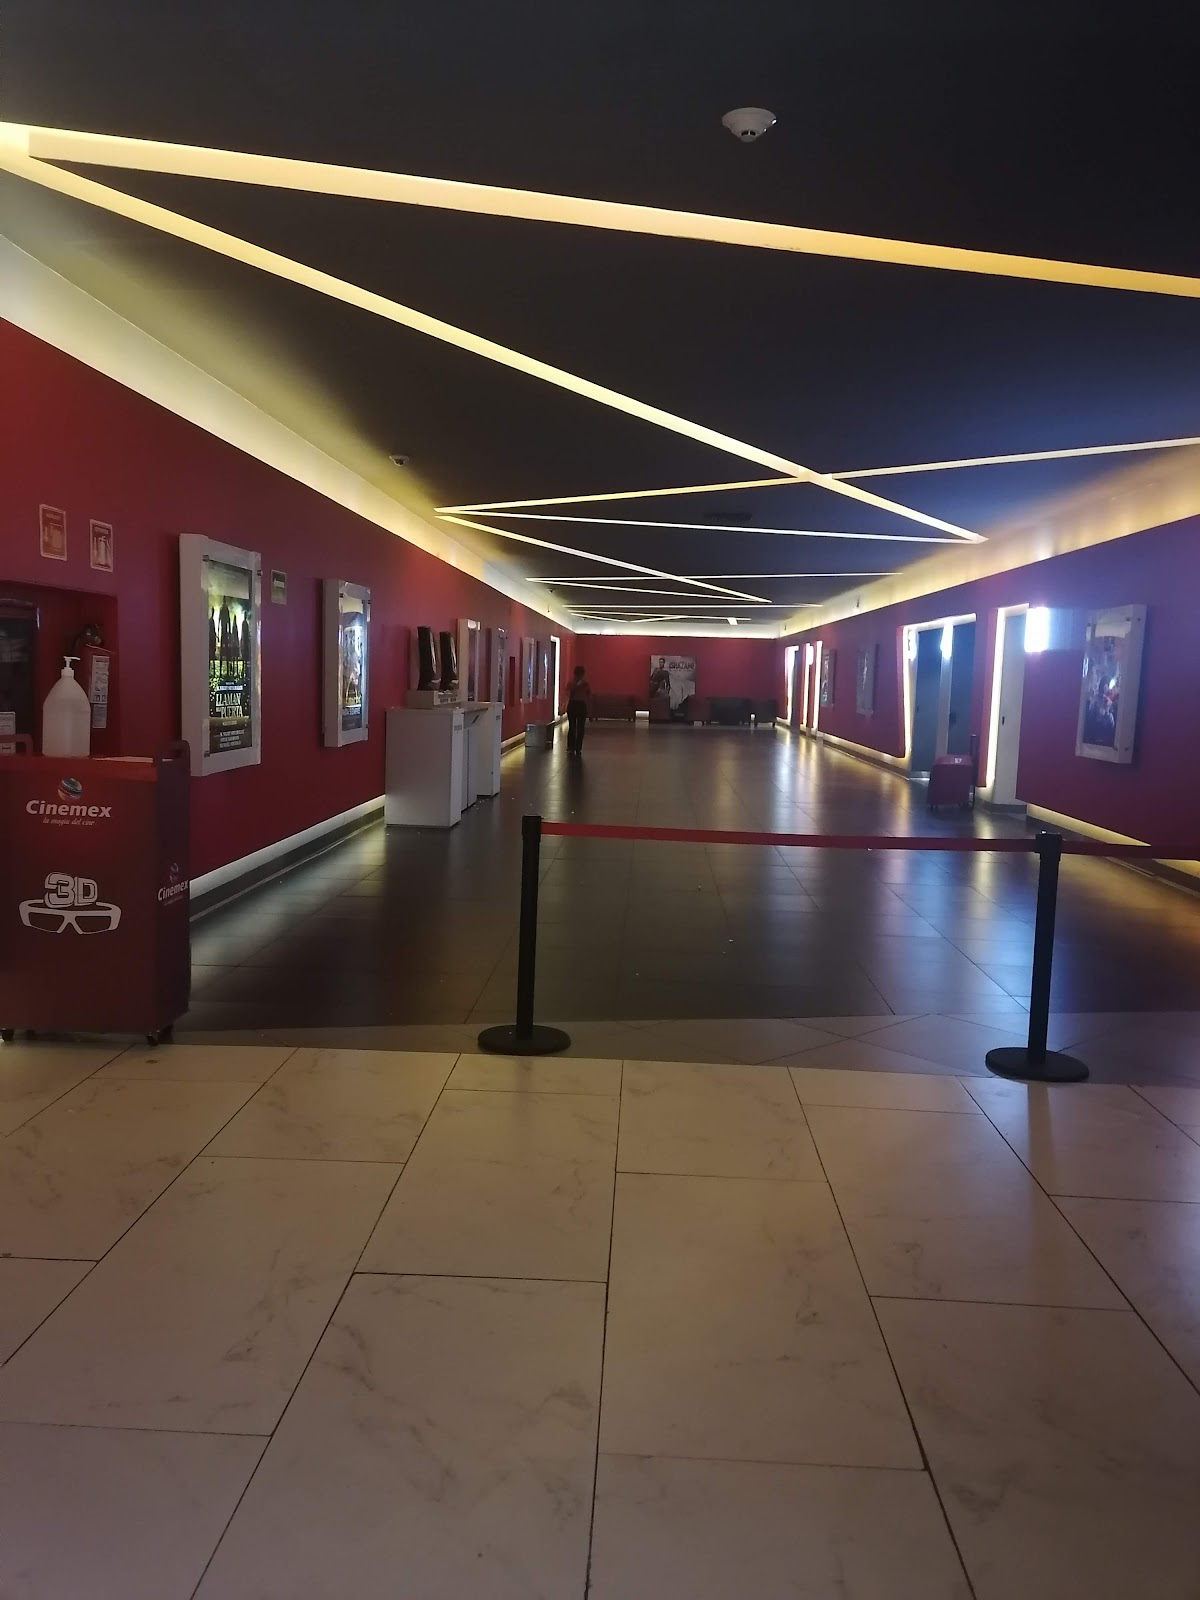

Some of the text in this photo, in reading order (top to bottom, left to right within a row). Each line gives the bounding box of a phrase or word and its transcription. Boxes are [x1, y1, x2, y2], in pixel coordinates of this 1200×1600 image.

[216, 693, 241, 707] LLAMAN
[220, 705, 243, 719] PUERTA
[26, 800, 112, 818] Cinemex
[44, 871, 98, 909] 3D
[157, 880, 188, 901] Cinemex
